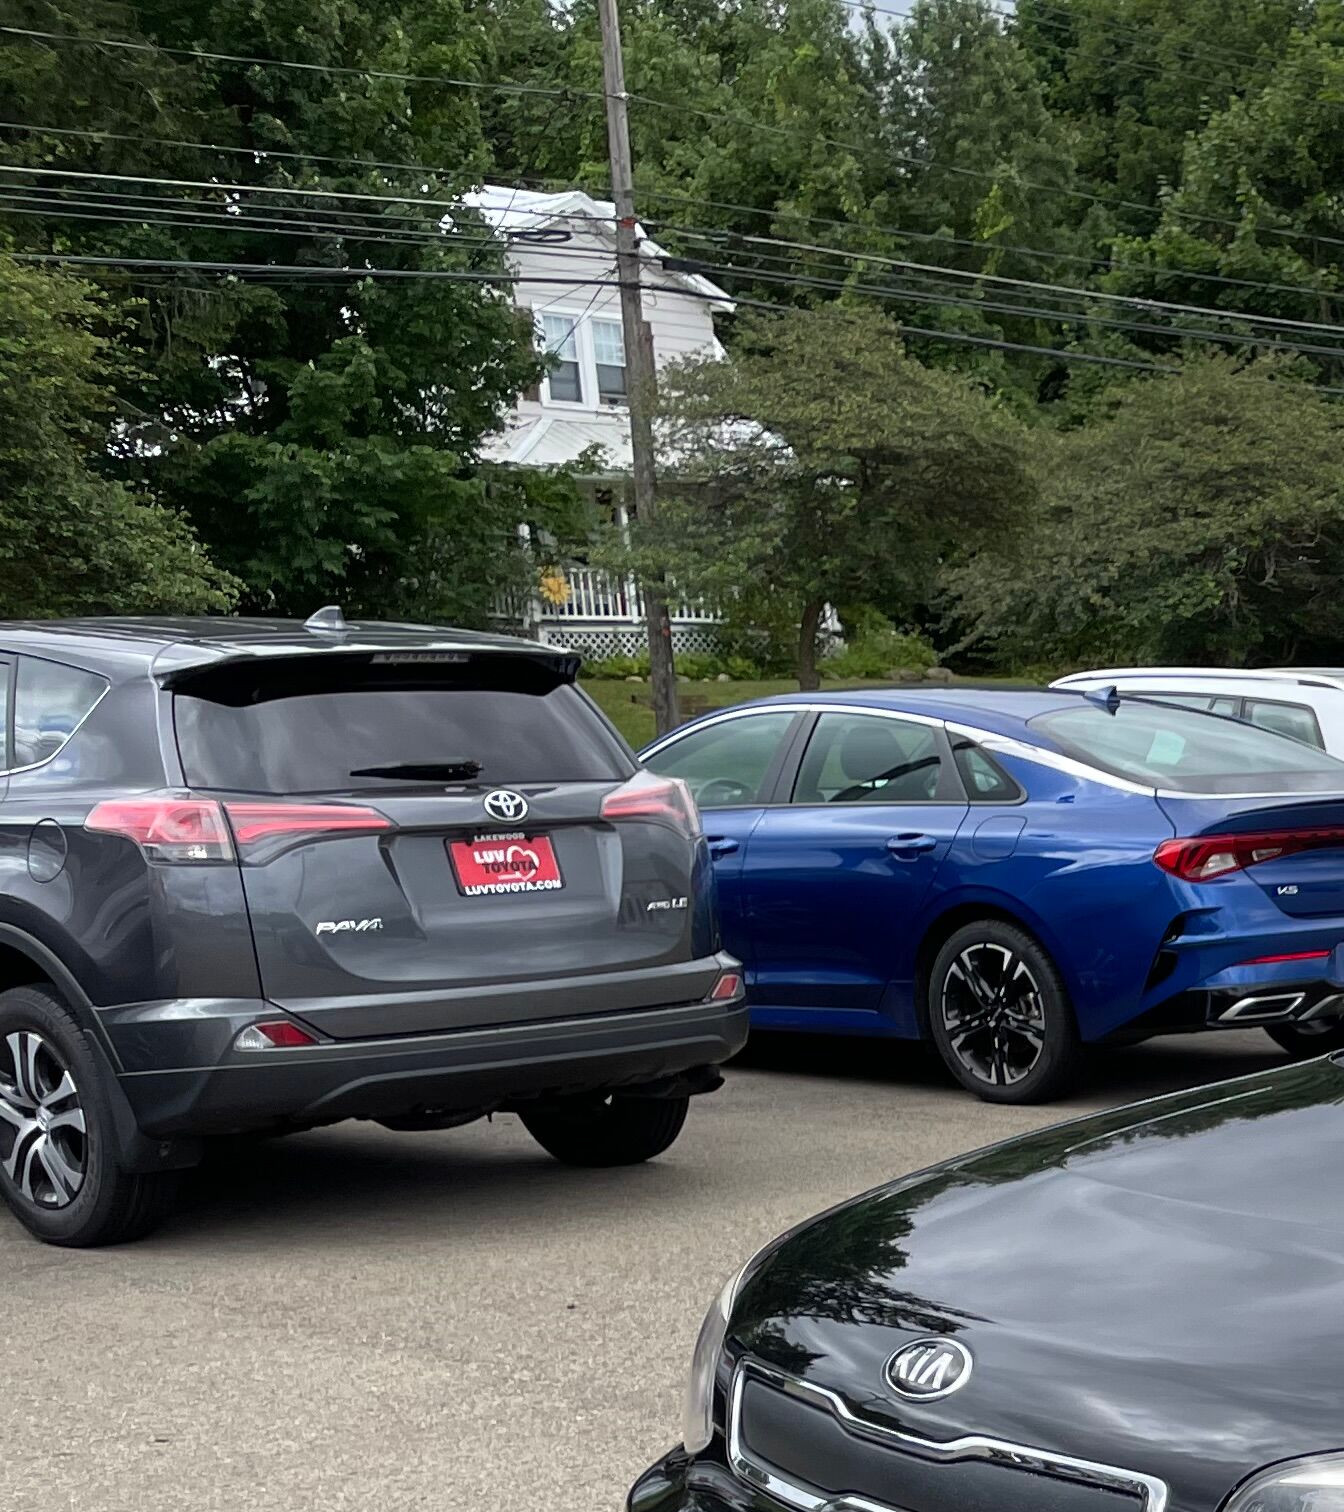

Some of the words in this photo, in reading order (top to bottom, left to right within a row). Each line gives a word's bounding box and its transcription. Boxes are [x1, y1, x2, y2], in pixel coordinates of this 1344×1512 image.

[474, 832, 525, 842] LAKEWOOD
[473, 850, 504, 864] LUV
[482, 861, 538, 874] TOYOTA
[465, 880, 562, 895] LUVTOYOTA.COM
[891, 1345, 954, 1389] KIA
